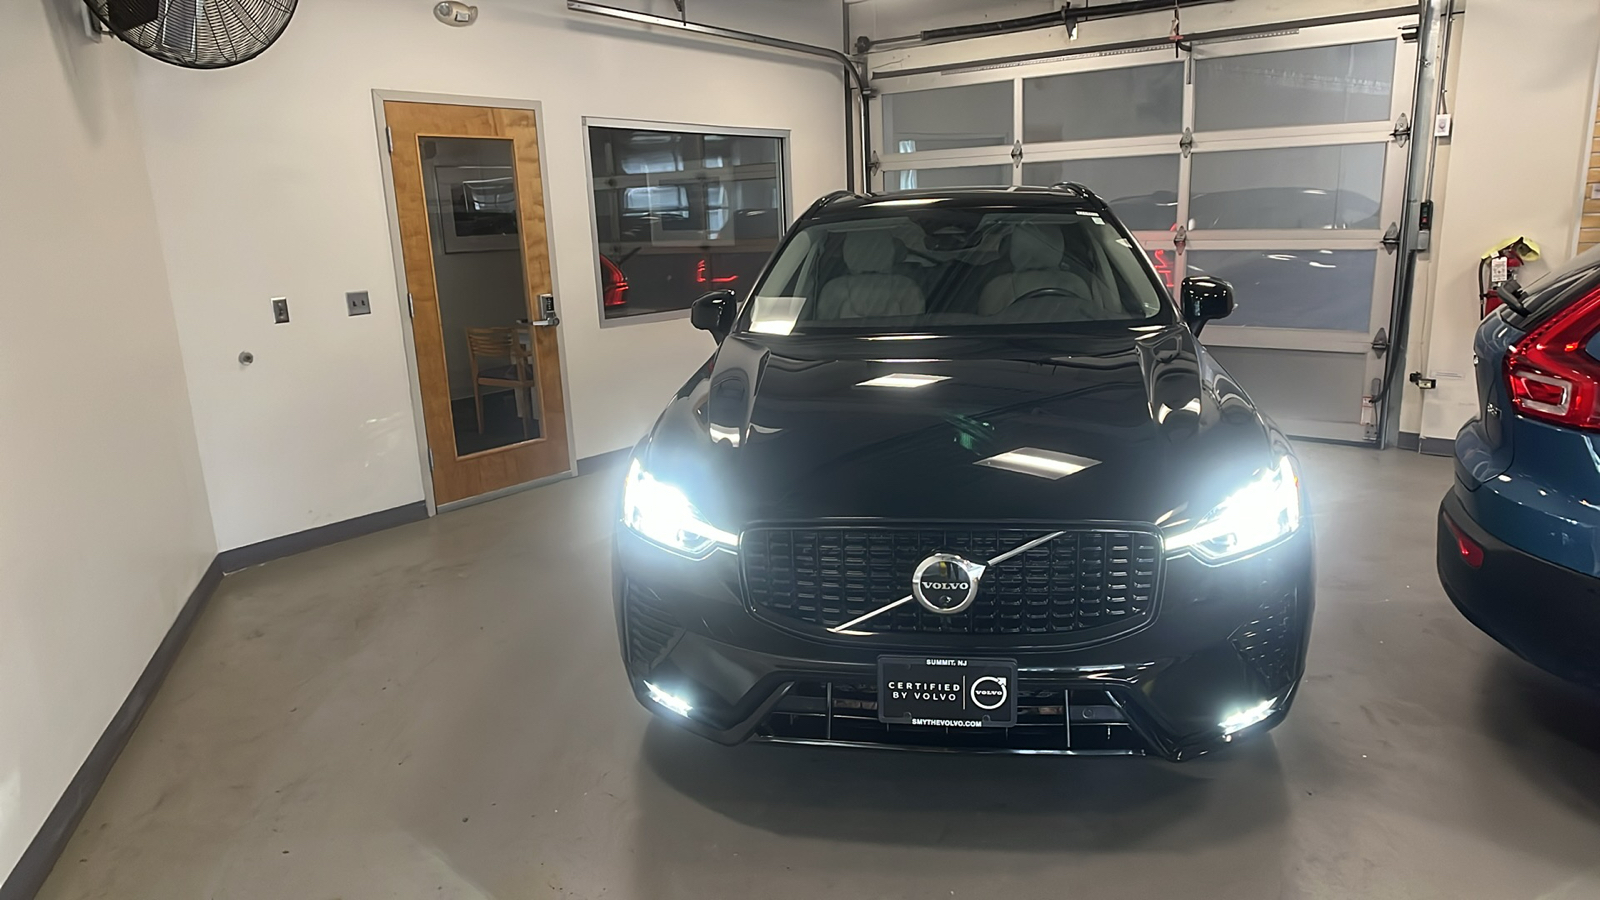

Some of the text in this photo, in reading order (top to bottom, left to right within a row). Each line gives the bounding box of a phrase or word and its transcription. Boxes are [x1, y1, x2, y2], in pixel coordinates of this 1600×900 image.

[921, 581, 969, 590] VOLVO
[957, 659, 968, 667] NJ
[888, 681, 961, 692] CERTIFIED
[892, 691, 957, 701] BY VOLVO
[911, 718, 983, 728] SMYTHEVOLVO.COM
